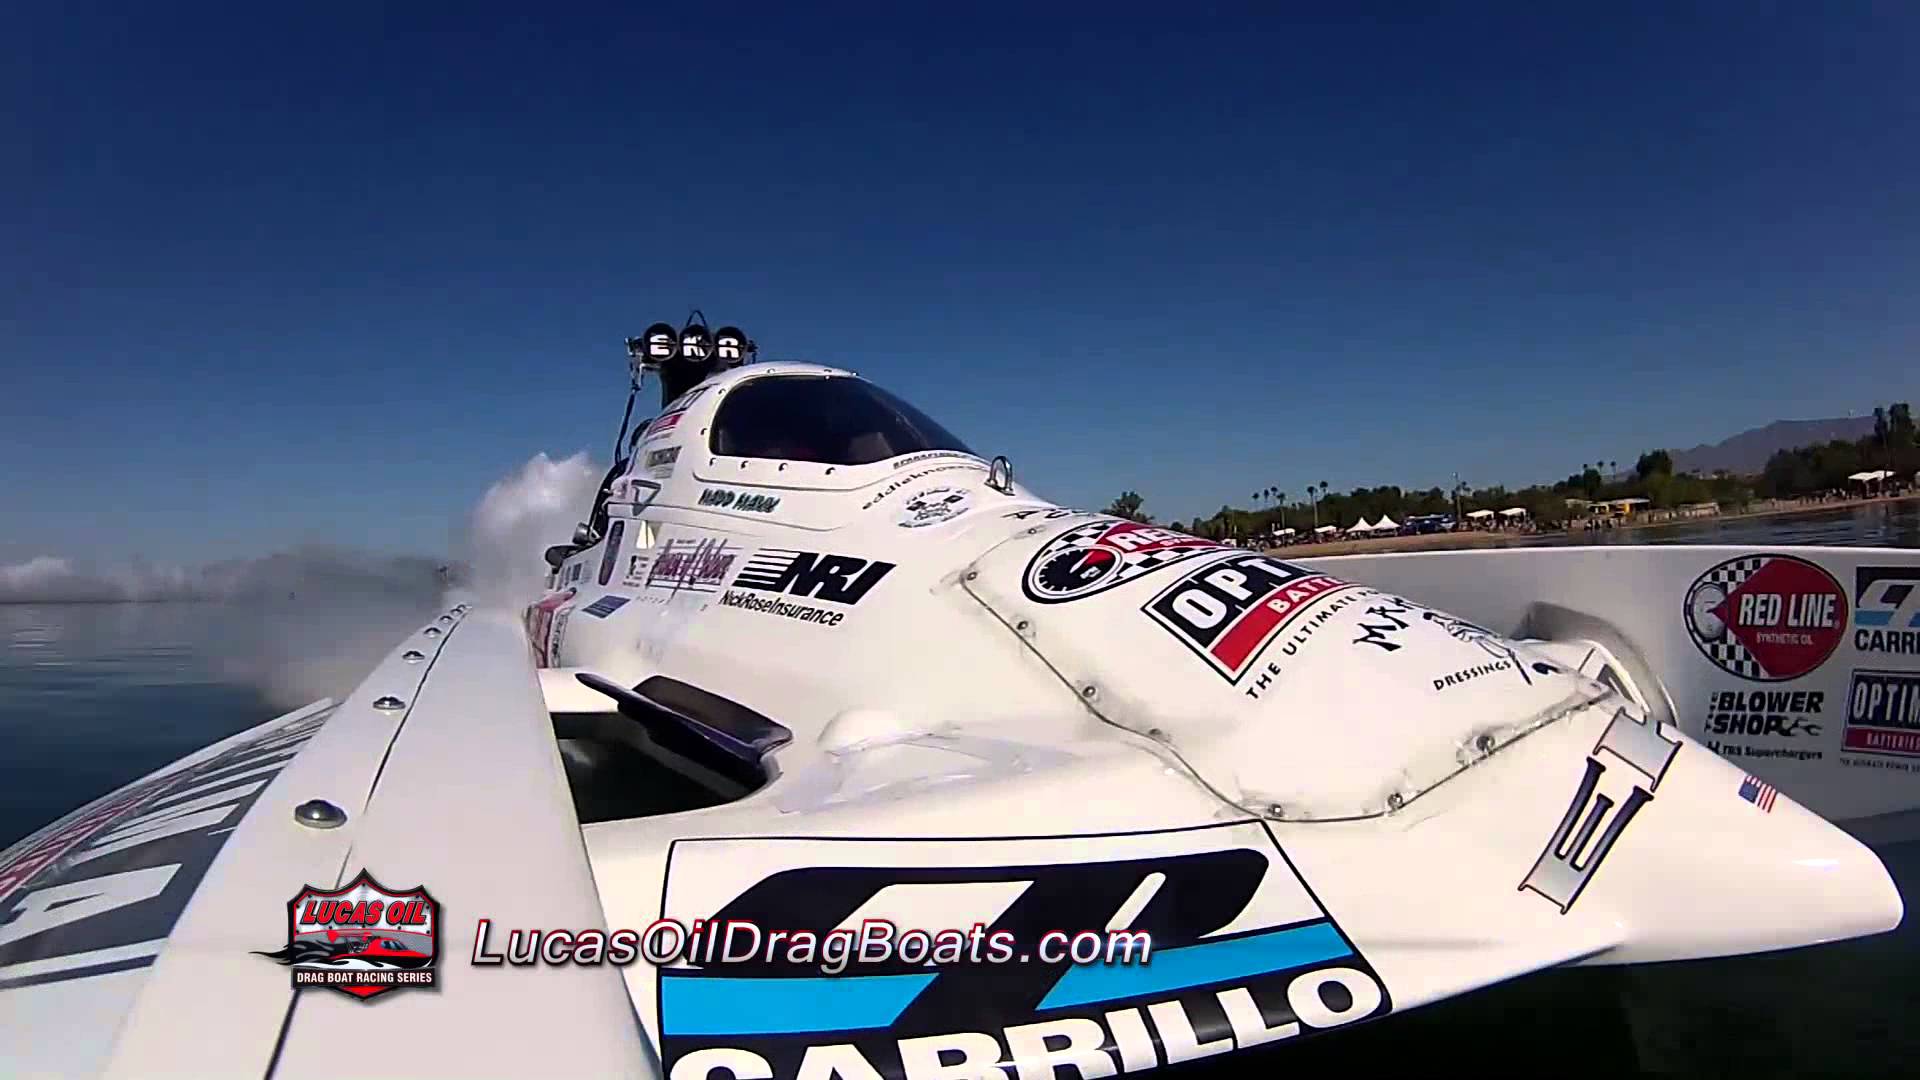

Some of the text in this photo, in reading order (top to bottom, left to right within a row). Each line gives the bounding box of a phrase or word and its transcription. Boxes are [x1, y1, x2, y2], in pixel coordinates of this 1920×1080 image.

[1738, 593, 1837, 628] RED LINE
[1246, 662, 1282, 700] THE
[1433, 660, 1512, 691] DRESSINGS
[1718, 691, 1824, 713] BLOWER
[1712, 714, 1784, 736] SHOP
